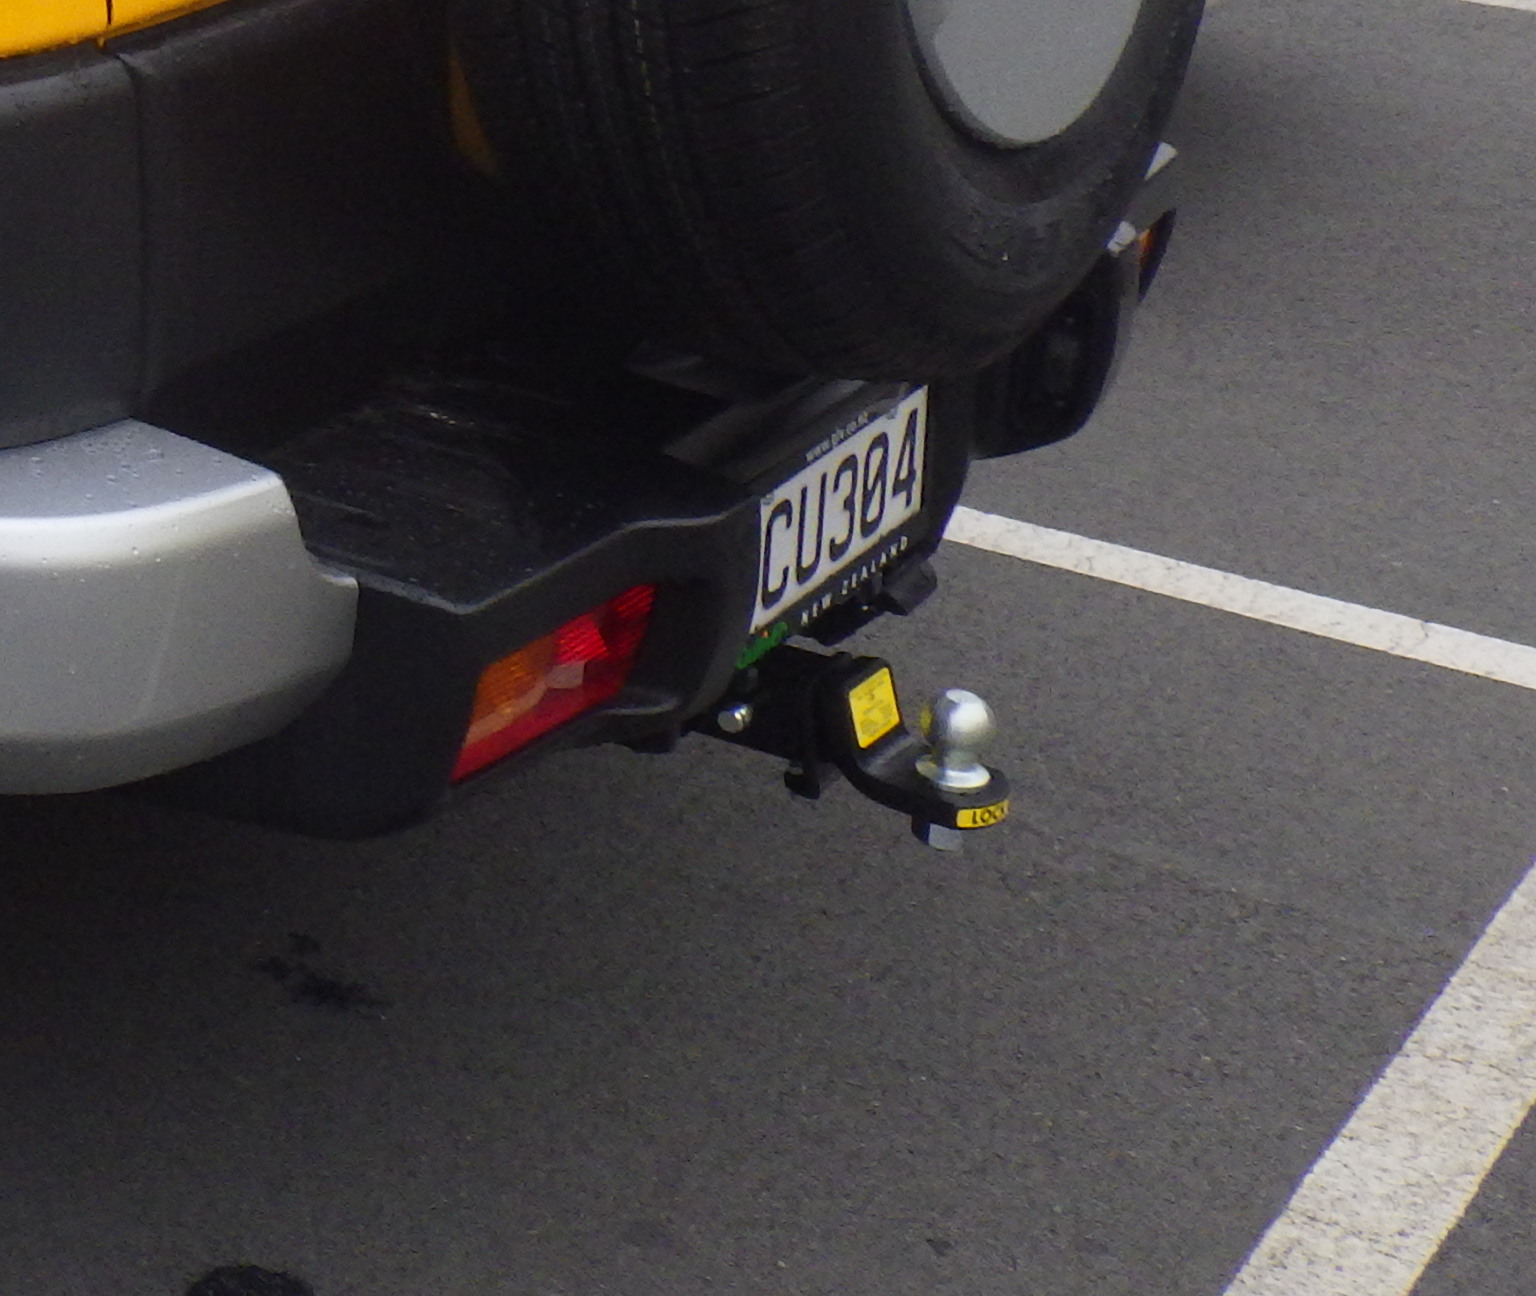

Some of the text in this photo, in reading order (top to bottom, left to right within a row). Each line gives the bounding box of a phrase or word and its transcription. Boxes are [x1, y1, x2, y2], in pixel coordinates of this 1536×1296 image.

[760, 407, 919, 610] CU304
[801, 535, 908, 626] NEW ZEALAND
